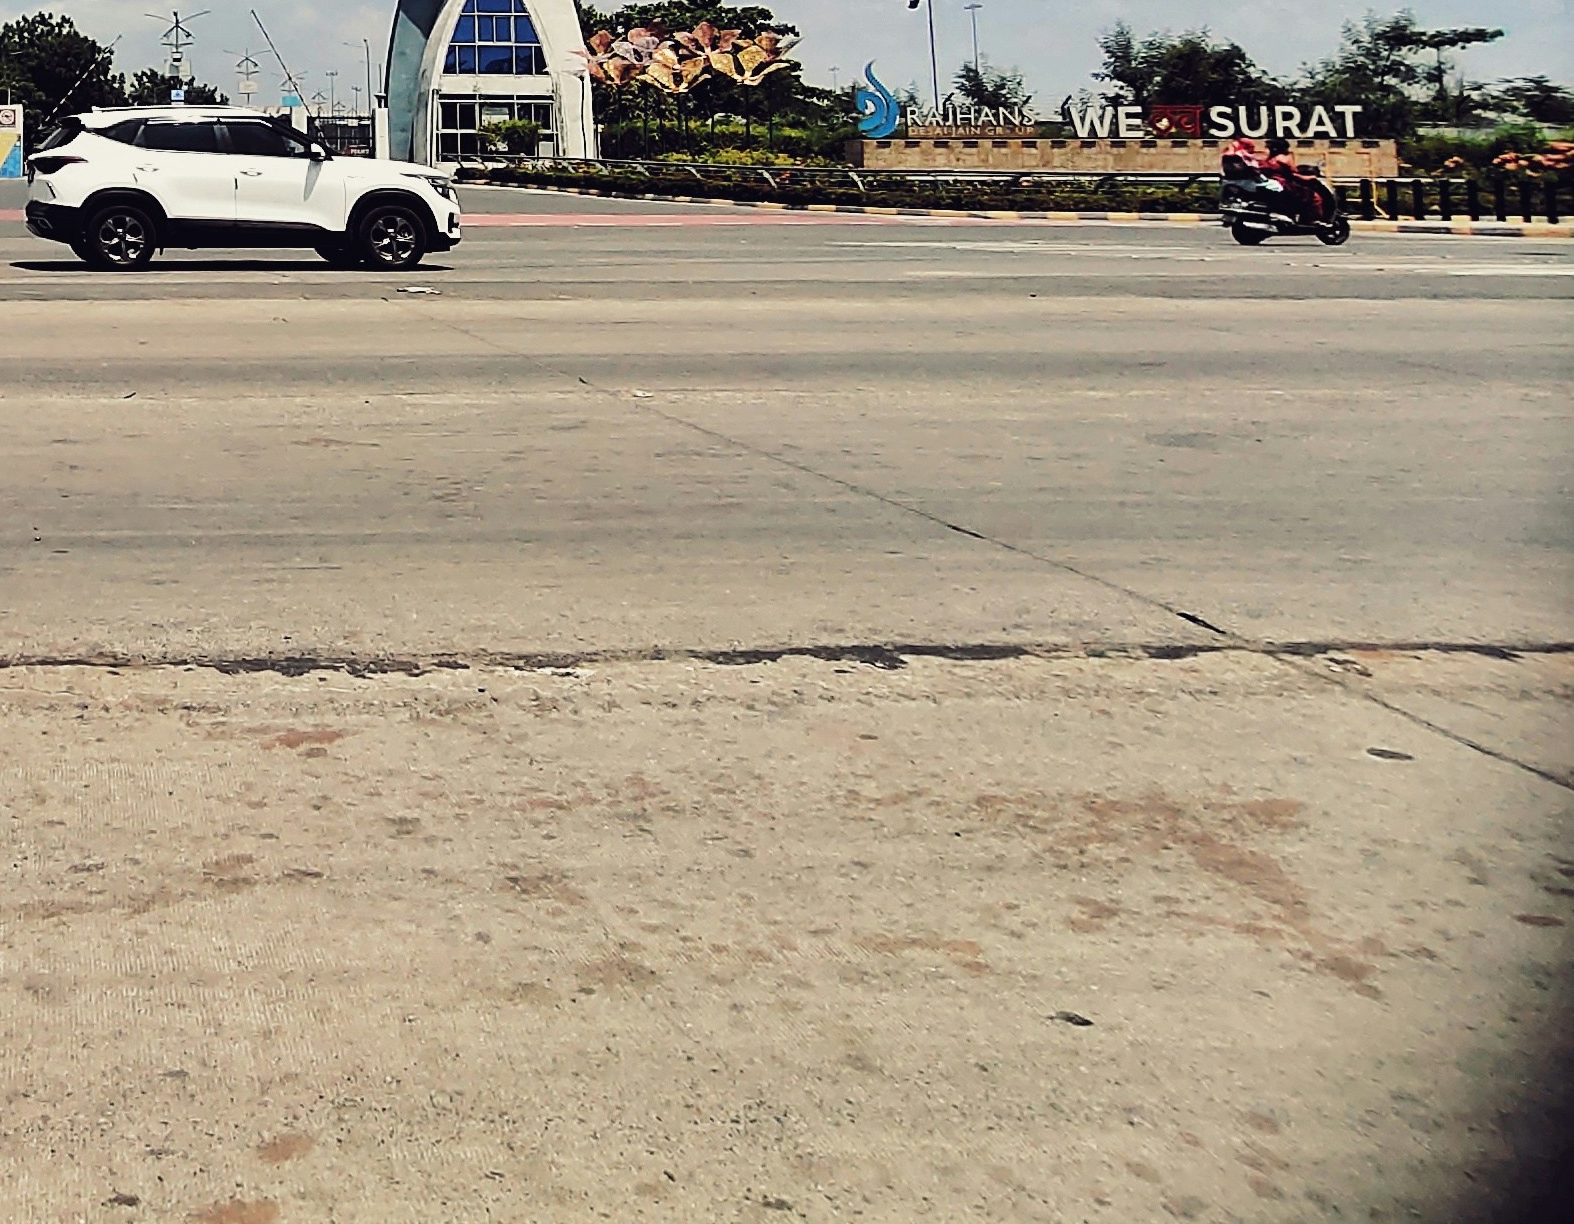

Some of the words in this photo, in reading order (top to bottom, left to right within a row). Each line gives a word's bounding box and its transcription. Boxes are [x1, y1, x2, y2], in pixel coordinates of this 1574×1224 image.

[906, 105, 1035, 126] RAJHANS
[1068, 104, 1145, 138] WE
[1208, 104, 1363, 138] SURAT
[985, 126, 1034, 136] GRUP
